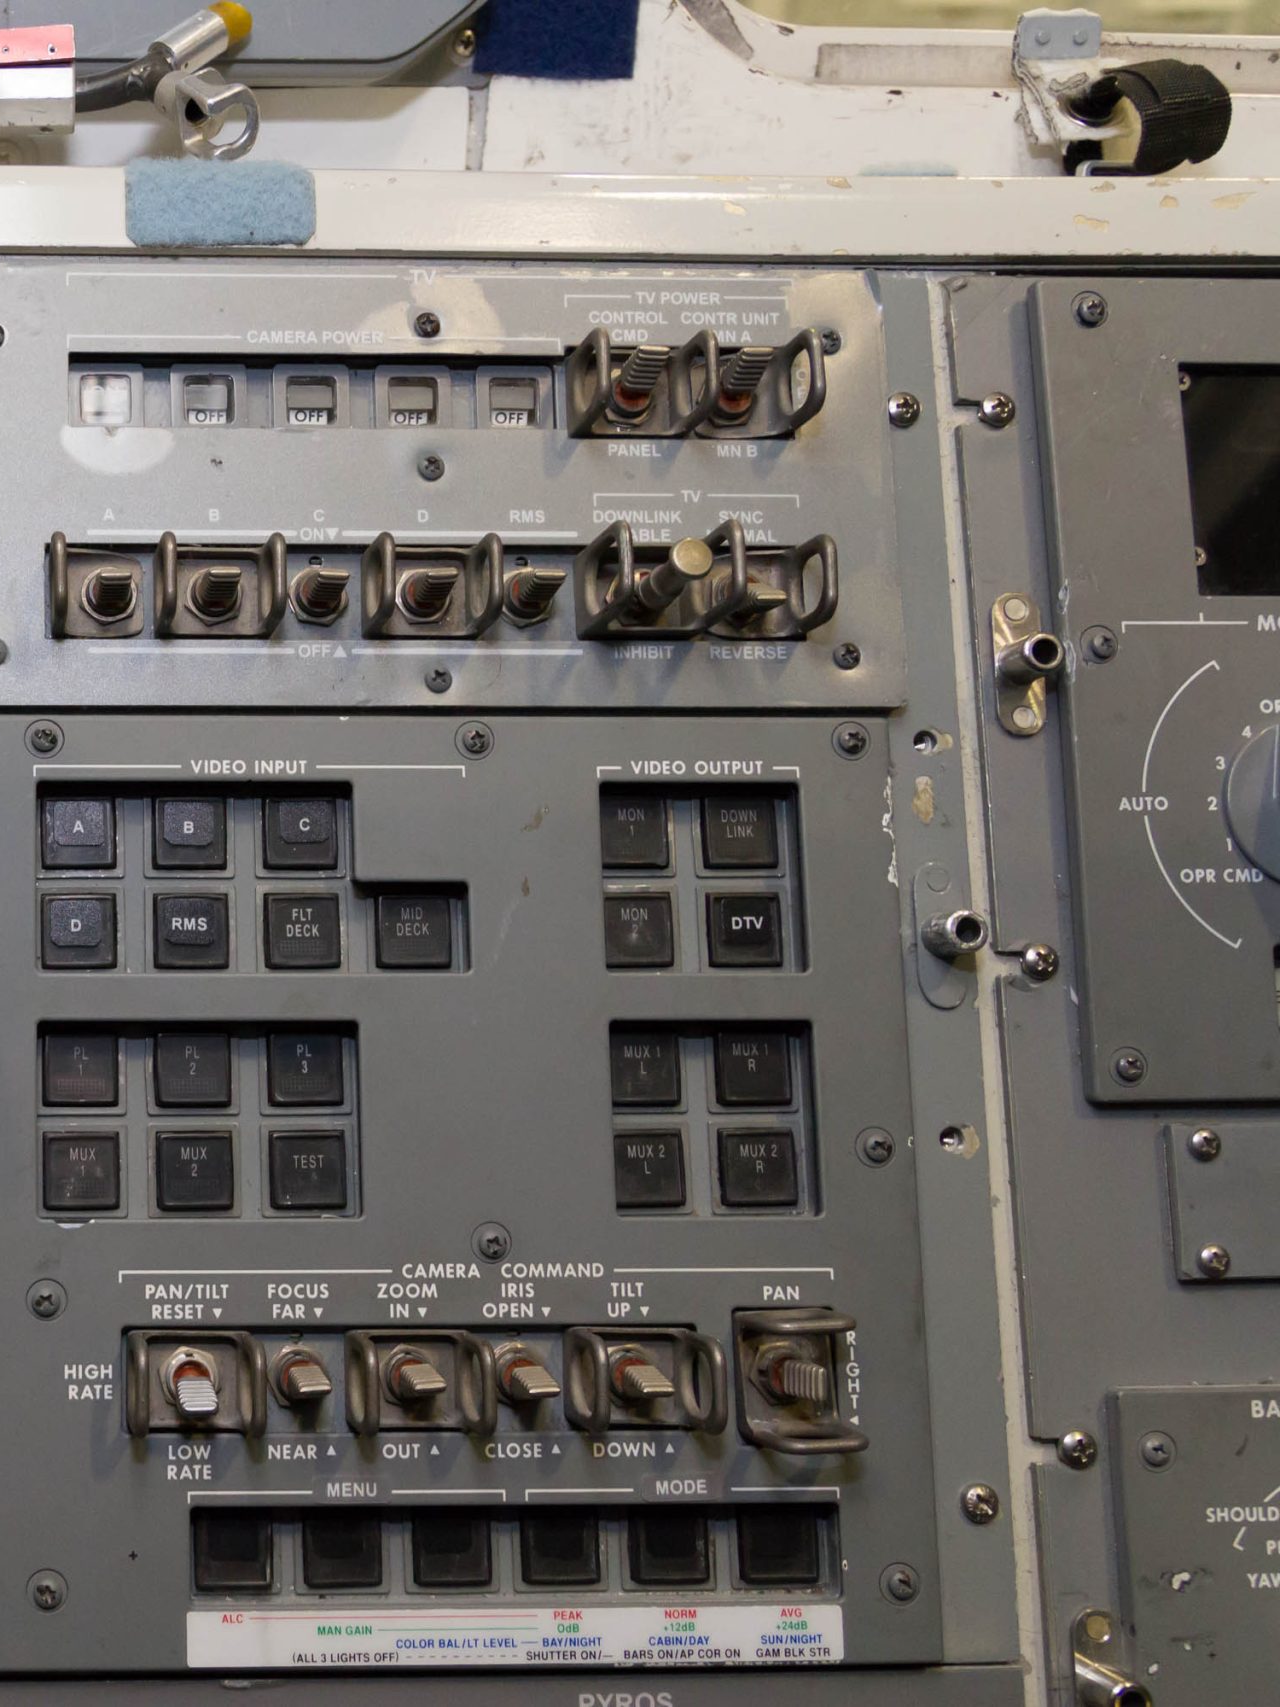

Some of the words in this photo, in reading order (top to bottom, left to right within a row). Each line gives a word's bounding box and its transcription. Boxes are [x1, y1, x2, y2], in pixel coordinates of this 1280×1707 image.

[636, 292, 655, 305] TV
[661, 292, 720, 305] POWER
[589, 311, 668, 325] CONTROL
[681, 312, 738, 325] CONTR
[742, 312, 780, 326] UNIT
[247, 330, 317, 344] CAMERA
[322, 331, 383, 345] POWER
[611, 329, 648, 342] CMD
[195, 411, 225, 423] OFF
[294, 411, 324, 423] OFF
[394, 412, 423, 424] OFF
[495, 412, 524, 424] OFF
[608, 444, 661, 457] PANEL
[681, 490, 702, 503] TV
[103, 508, 115, 522] A
[209, 509, 220, 522] B
[313, 509, 325, 522] C
[418, 510, 429, 523] D
[509, 510, 545, 523] RMS
[593, 510, 682, 524] DOWNLINK
[718, 510, 763, 524] SYNC
[300, 527, 325, 541] ON
[298, 644, 331, 658] OFF
[614, 646, 675, 660] INHIBIT
[710, 646, 787, 660] REVERSE
[1241, 726, 1251, 738] 4
[190, 760, 246, 774] VIDEO
[255, 760, 307, 774] INPUT
[630, 760, 686, 775] VIDEO
[694, 760, 763, 775] OUTPUT
[1215, 756, 1225, 770] 3
[1118, 797, 1169, 811] AUTO
[618, 808, 645, 821] MON
[721, 809, 757, 823] DOWN
[72, 820, 84, 833] A
[183, 821, 194, 833] B
[299, 818, 310, 831] C
[726, 825, 754, 839] LINK
[1180, 868, 1216, 883] OPR
[1223, 868, 1263, 883] CMD
[292, 908, 312, 921] FLT
[401, 907, 423, 920] MID
[621, 908, 648, 921] MON
[71, 919, 82, 932] D
[171, 918, 208, 932] RMS
[396, 922, 430, 936] DECK
[731, 916, 763, 930] DTV
[286, 924, 320, 937] DECK
[624, 1046, 650, 1058] MUX
[301, 1060, 308, 1073] 3
[69, 1148, 96, 1161] MUX
[181, 1147, 207, 1161] MUX
[627, 1145, 653, 1158] MUX
[740, 1144, 766, 1157] MUX
[293, 1155, 325, 1169] TEST
[402, 1263, 480, 1279] CAMERA
[501, 1262, 604, 1278] COMMAND
[145, 1284, 229, 1300] PAN/TILT
[267, 1283, 329, 1299] FOCUS
[377, 1283, 438, 1298] ZOOM
[501, 1282, 535, 1298] IRIS
[611, 1282, 644, 1298] TILT
[763, 1286, 800, 1300] PAN
[151, 1304, 204, 1319] RESET
[272, 1304, 305, 1319] FAR
[390, 1303, 409, 1318] IN
[482, 1303, 534, 1318] OPEN
[607, 1302, 631, 1317] UP
[64, 1364, 113, 1380] HIGH
[846, 1331, 860, 1409] RIGHT
[68, 1385, 113, 1400] RATE
[168, 1445, 211, 1460] LOW
[268, 1444, 317, 1459] NEAR
[382, 1443, 420, 1459] OUT
[485, 1443, 542, 1458] CLOSE
[593, 1442, 656, 1457] DOWN
[167, 1465, 212, 1480] RATE
[327, 1482, 378, 1498] MENU
[655, 1479, 708, 1495] MODE
[222, 1613, 244, 1624] ALC
[553, 1611, 583, 1621] PEAK
[664, 1609, 697, 1619] NORM
[780, 1608, 802, 1618] AVG
[317, 1625, 342, 1636] MAN
[345, 1625, 372, 1635] GAIN
[396, 1638, 435, 1649] COLOR
[438, 1638, 479, 1649] BAL/LT
[483, 1637, 517, 1648] LEVEL
[542, 1637, 602, 1647] BAY/NIGHT
[648, 1635, 711, 1647] CABIN/DAY
[760, 1634, 823, 1645] SUN/NIGHT
[292, 1652, 317, 1664] (ALL
[321, 1652, 327, 1663] 3
[330, 1652, 370, 1663] LIGHTS
[373, 1652, 399, 1664] OFF)
[526, 1650, 576, 1661] SHUTTER
[624, 1649, 654, 1660] BARS
[657, 1649, 694, 1660] ON/AP
[698, 1648, 723, 1659] COR
[725, 1648, 741, 1659] ON
[756, 1647, 781, 1658] GAM
[784, 1647, 806, 1657] BLK
[809, 1646, 831, 1657] STR
[578, 1692, 673, 1707] PYROS
